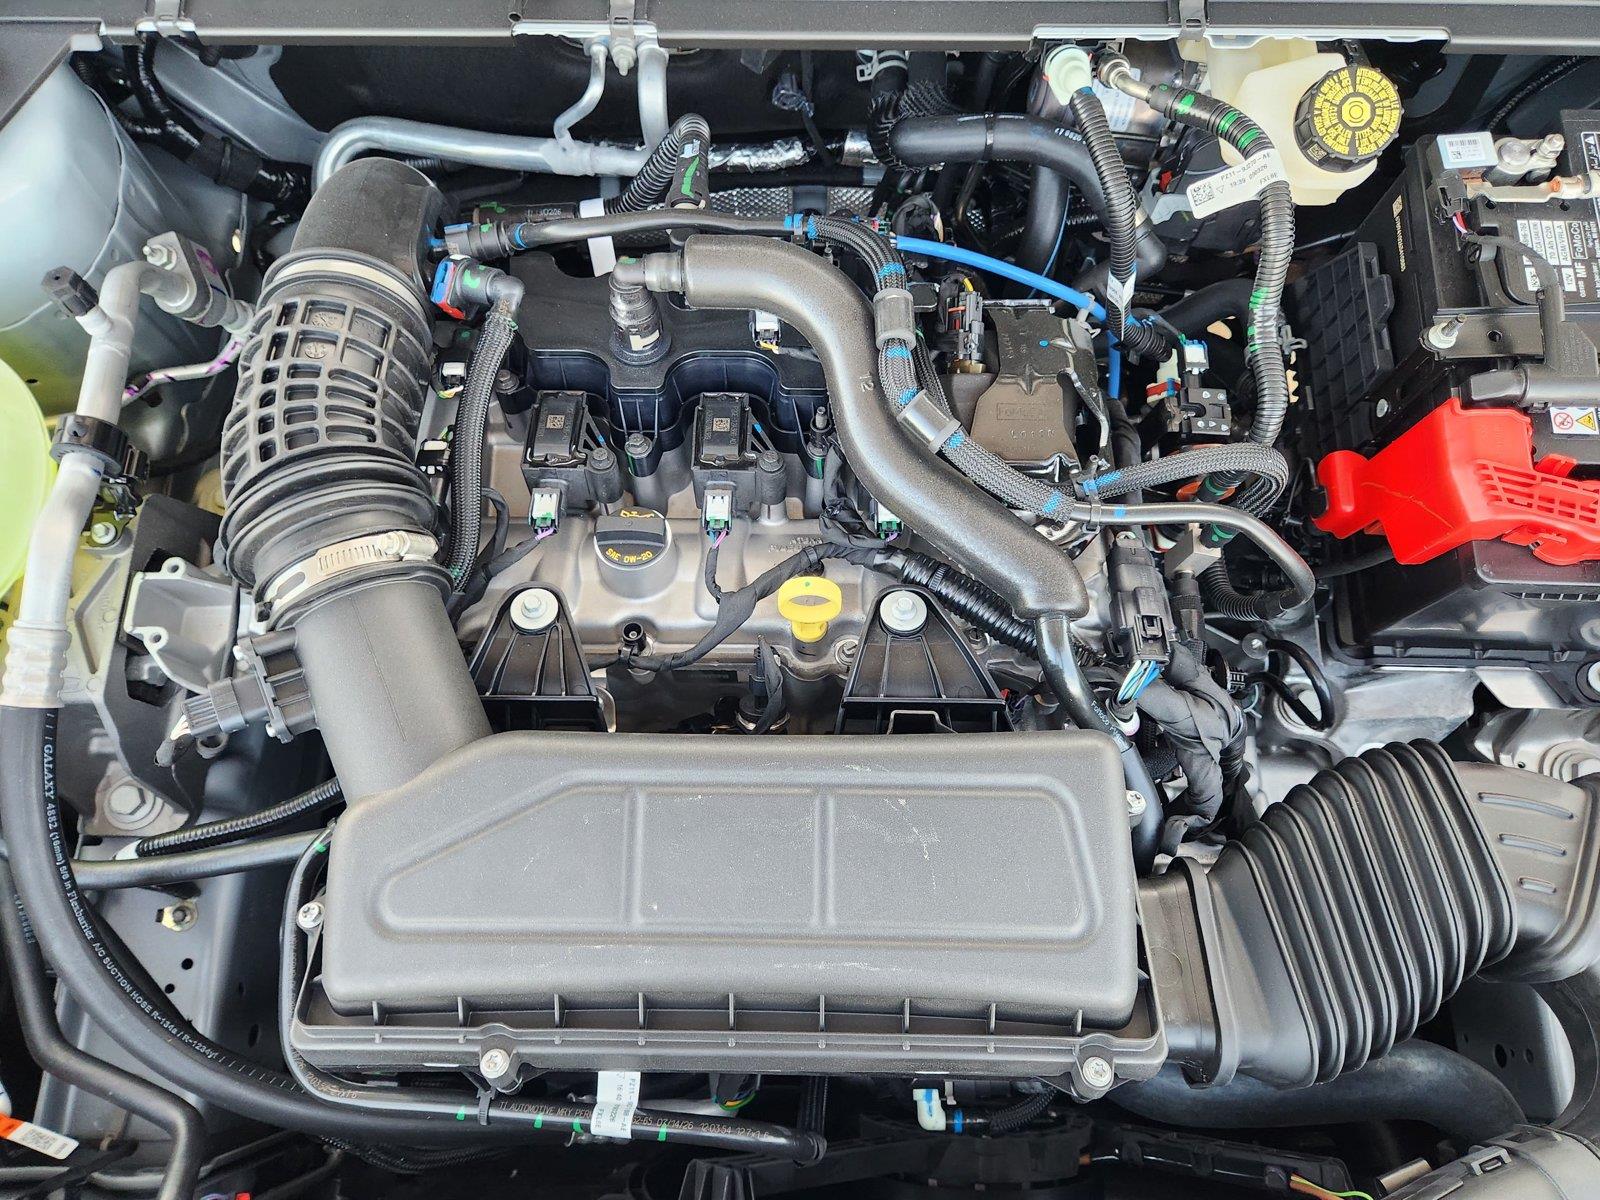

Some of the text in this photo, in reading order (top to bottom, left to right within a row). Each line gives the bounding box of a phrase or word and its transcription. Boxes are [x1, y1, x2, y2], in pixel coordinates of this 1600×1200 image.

[1571, 221, 1582, 258] FoMoCo
[1574, 261, 1586, 278] MF
[606, 548, 653, 563] SAE 0W-20
[43, 744, 54, 799] GALAXY
[46, 803, 58, 830] 4882
[50, 832, 65, 866] (16mm)
[66, 890, 94, 942] Flexbarrier
[93, 942, 105, 958] A/C
[103, 956, 133, 992] SUCTION
[130, 990, 153, 1014] HOSE
[151, 1010, 178, 1033] R-134a
[182, 1034, 218, 1059] R-1234yf
[508, 1102, 554, 1115] AUTOMOTIVE
